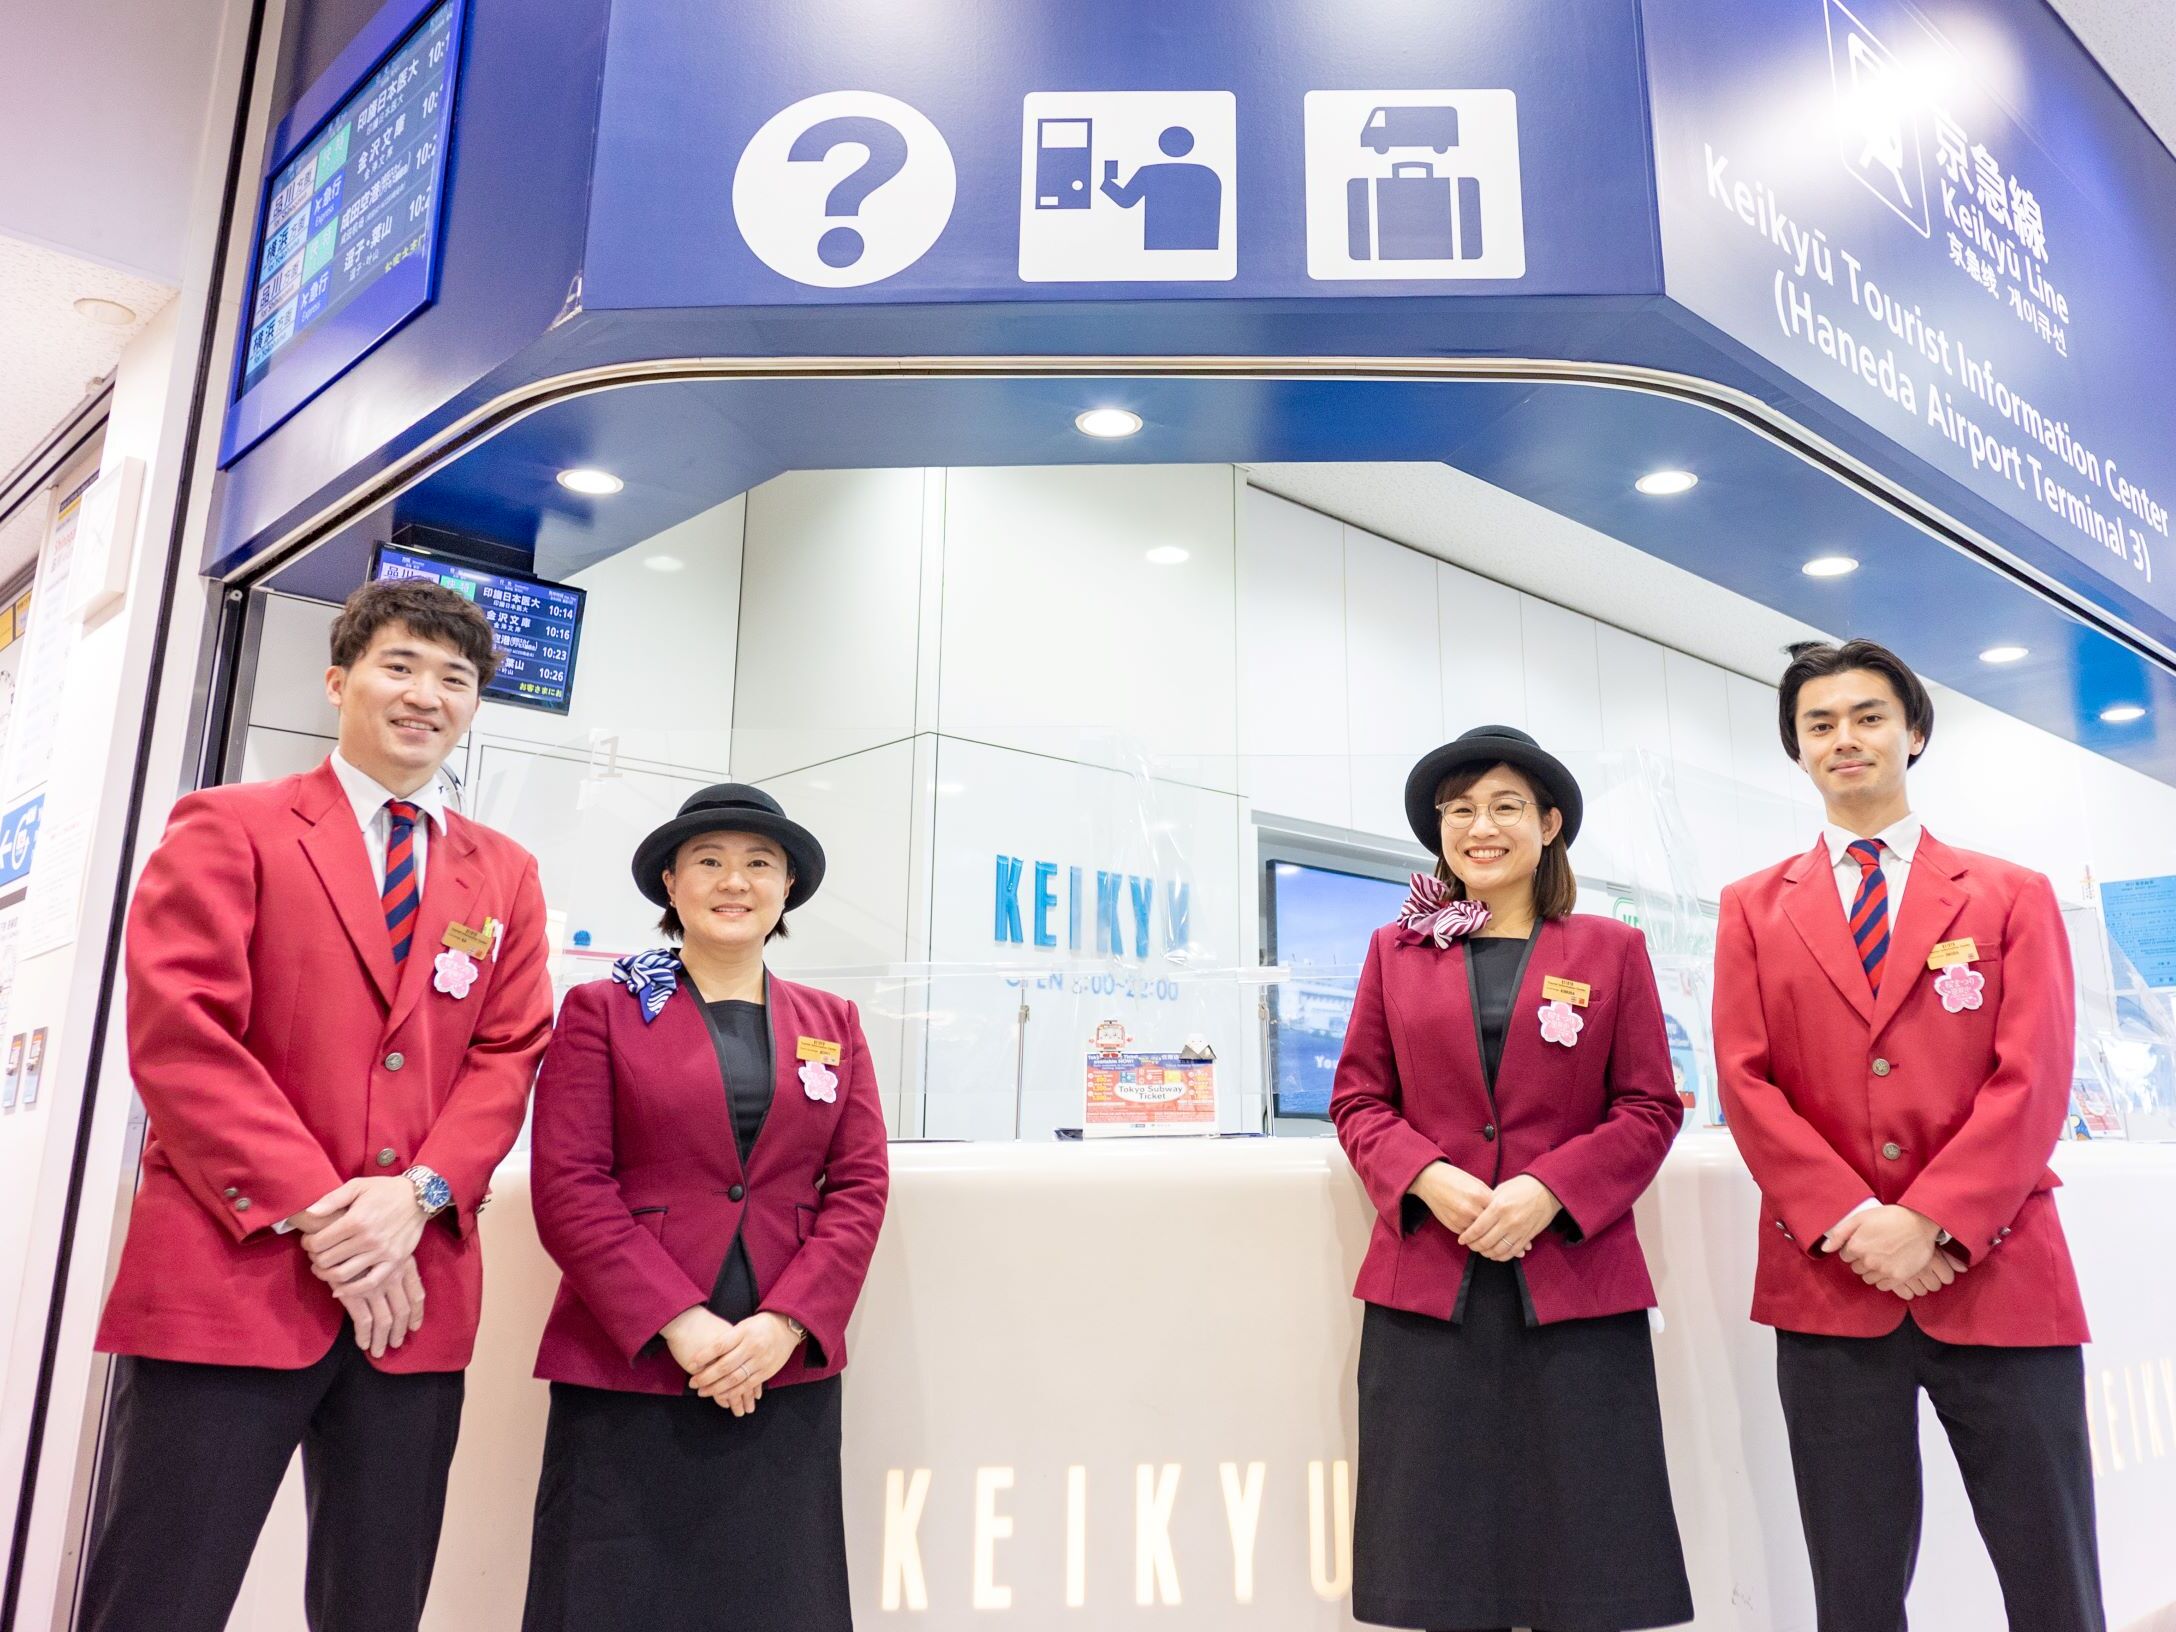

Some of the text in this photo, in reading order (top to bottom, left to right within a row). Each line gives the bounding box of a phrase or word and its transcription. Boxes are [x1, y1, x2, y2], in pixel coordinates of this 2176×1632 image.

[1934, 112, 2049, 264] 京急線
[1940, 178, 2070, 325] Keikyū Line
[1704, 142, 2169, 538] Keikyū Tourist Information Center
[1774, 267, 2152, 583] (Haneda Airport Terminal 3)
[486, 609, 531, 628] 金沢文庫
[549, 605, 573, 620] 10:14
[546, 626, 570, 640] 10:16
[542, 647, 567, 661] 10:23
[539, 668, 564, 682] 10:26
[1120, 1085, 1183, 1094] Tokyo Subway
[881, 1460, 1353, 1611] KEIKYU
